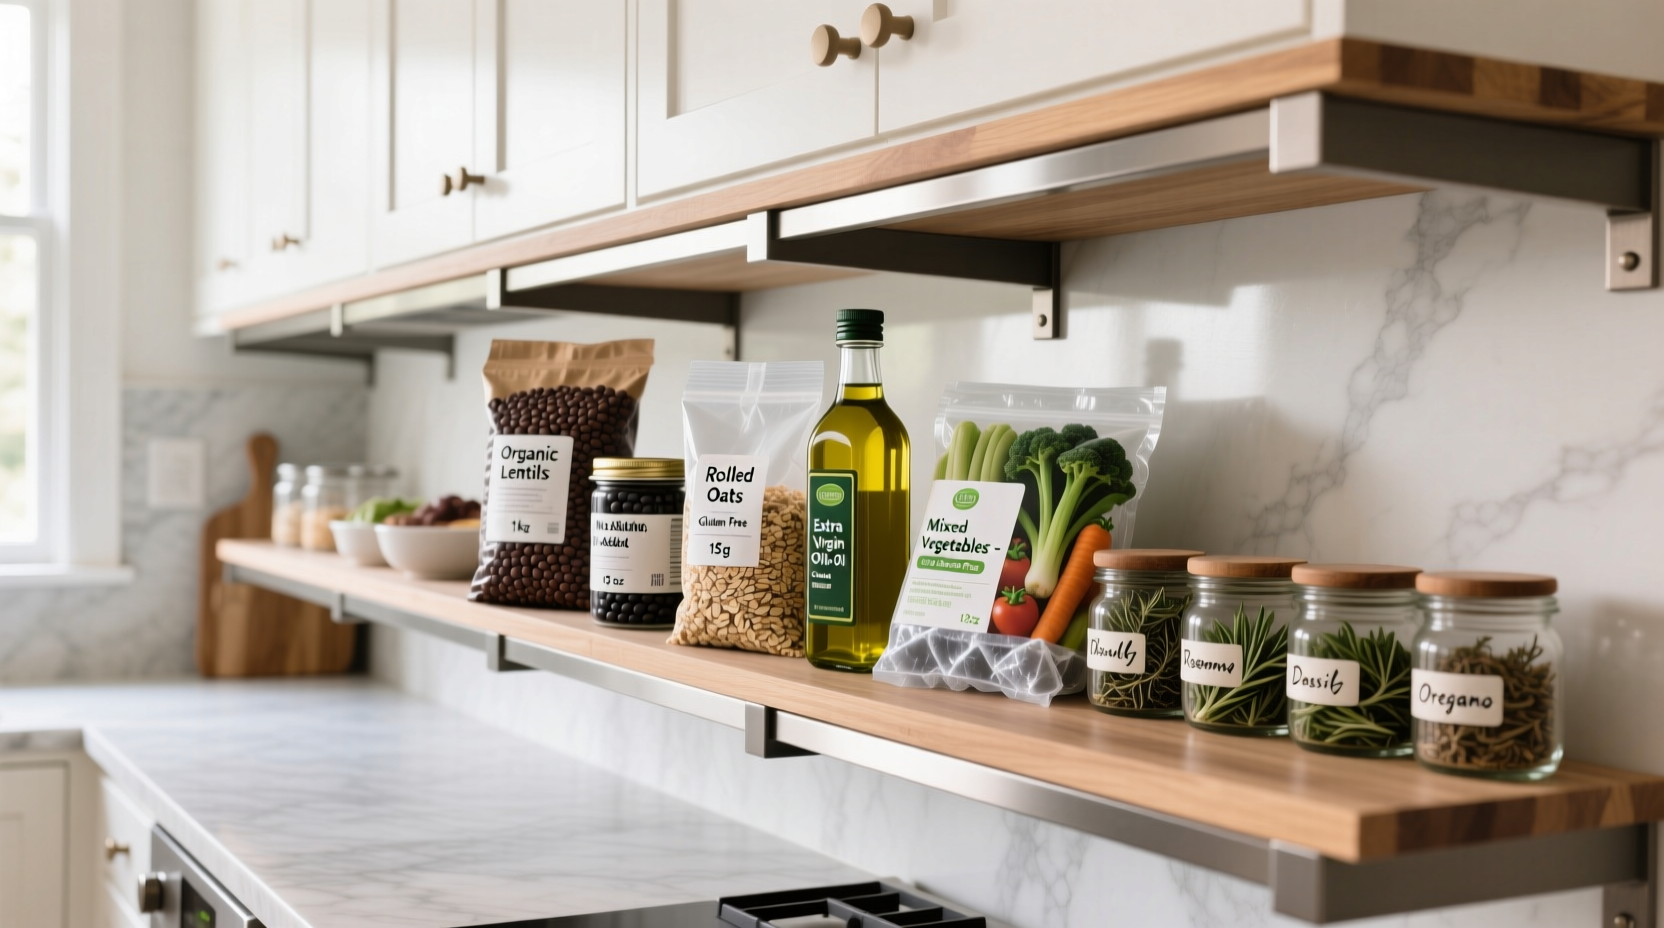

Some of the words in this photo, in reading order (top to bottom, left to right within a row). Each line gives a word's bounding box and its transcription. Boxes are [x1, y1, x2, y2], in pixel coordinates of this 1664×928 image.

[501, 445, 559, 463] Organic
[501, 464, 550, 480] Lentils
[705, 466, 755, 482] Rolled
[707, 487, 744, 504] Oats
[813, 518, 843, 533] Extra
[927, 518, 969, 534] Mixed
[709, 542, 731, 558] 15g
[812, 535, 845, 552] Virgin
[922, 536, 991, 554] Vegetables
[1420, 683, 1493, 714] Oregano
